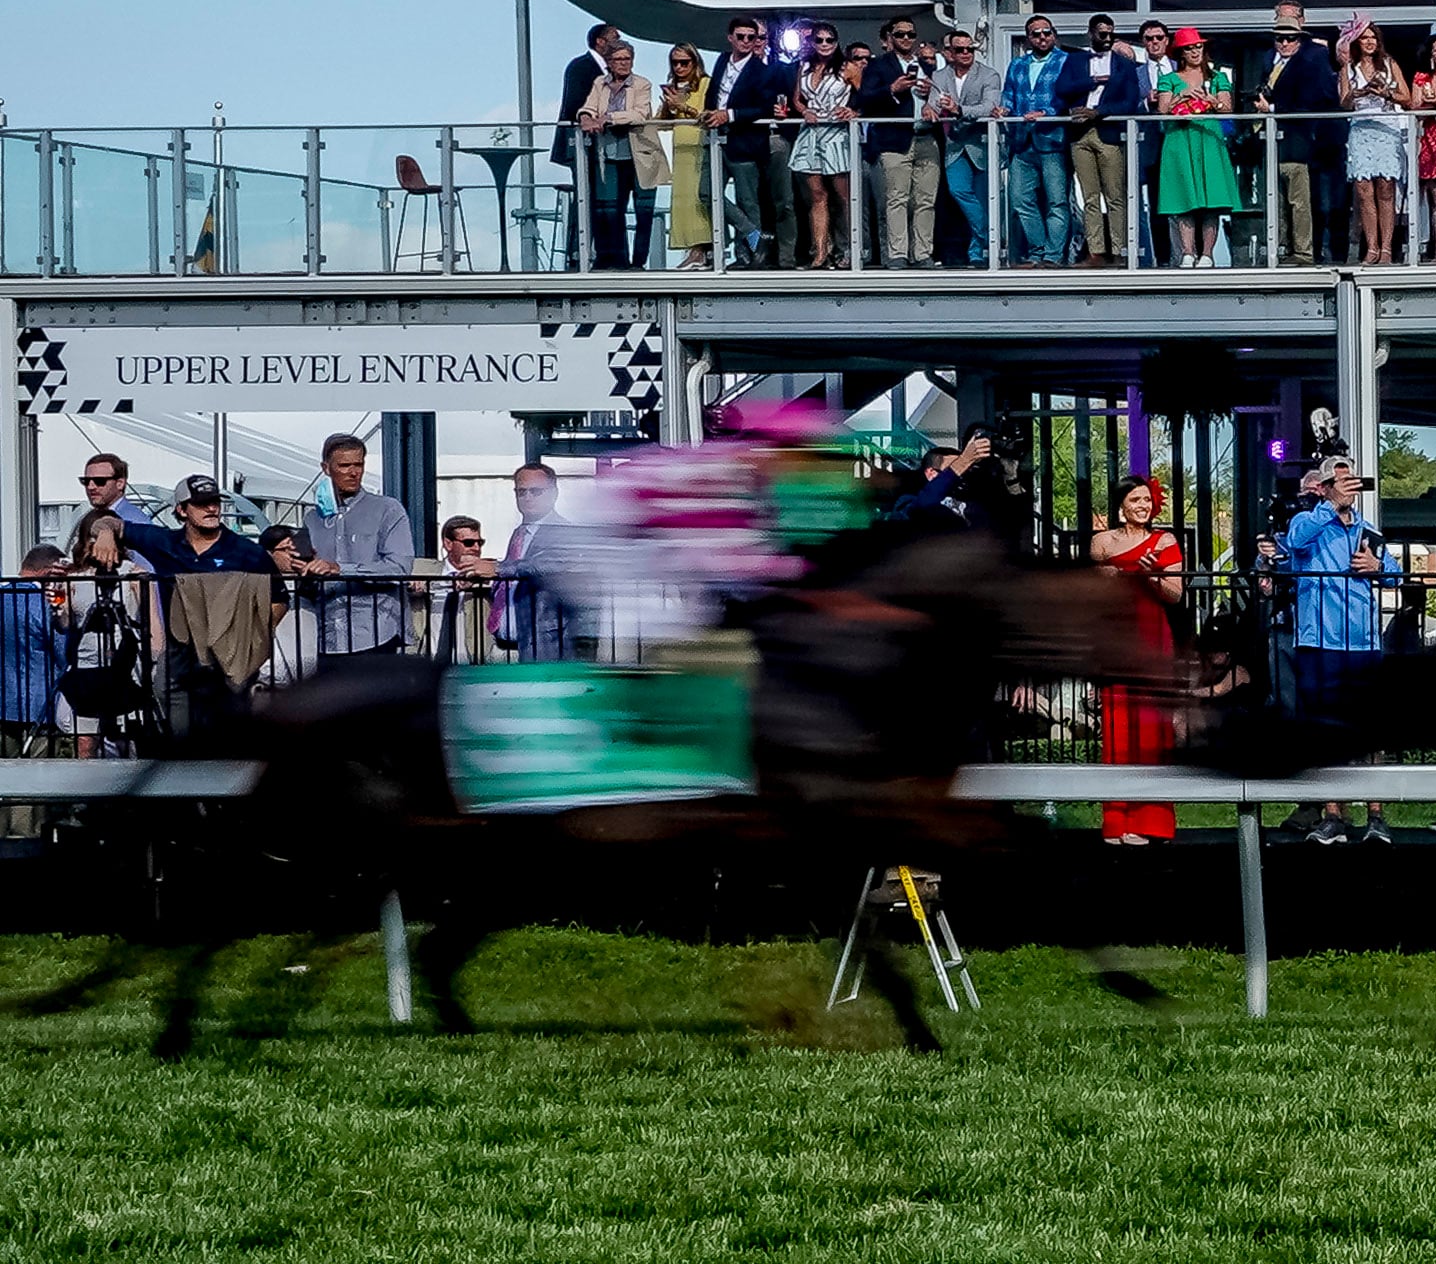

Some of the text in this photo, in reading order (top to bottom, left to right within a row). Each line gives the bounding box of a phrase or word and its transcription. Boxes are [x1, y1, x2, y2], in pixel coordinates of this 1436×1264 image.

[115, 353, 559, 385] UPPER LEVEL ENTRANCE
